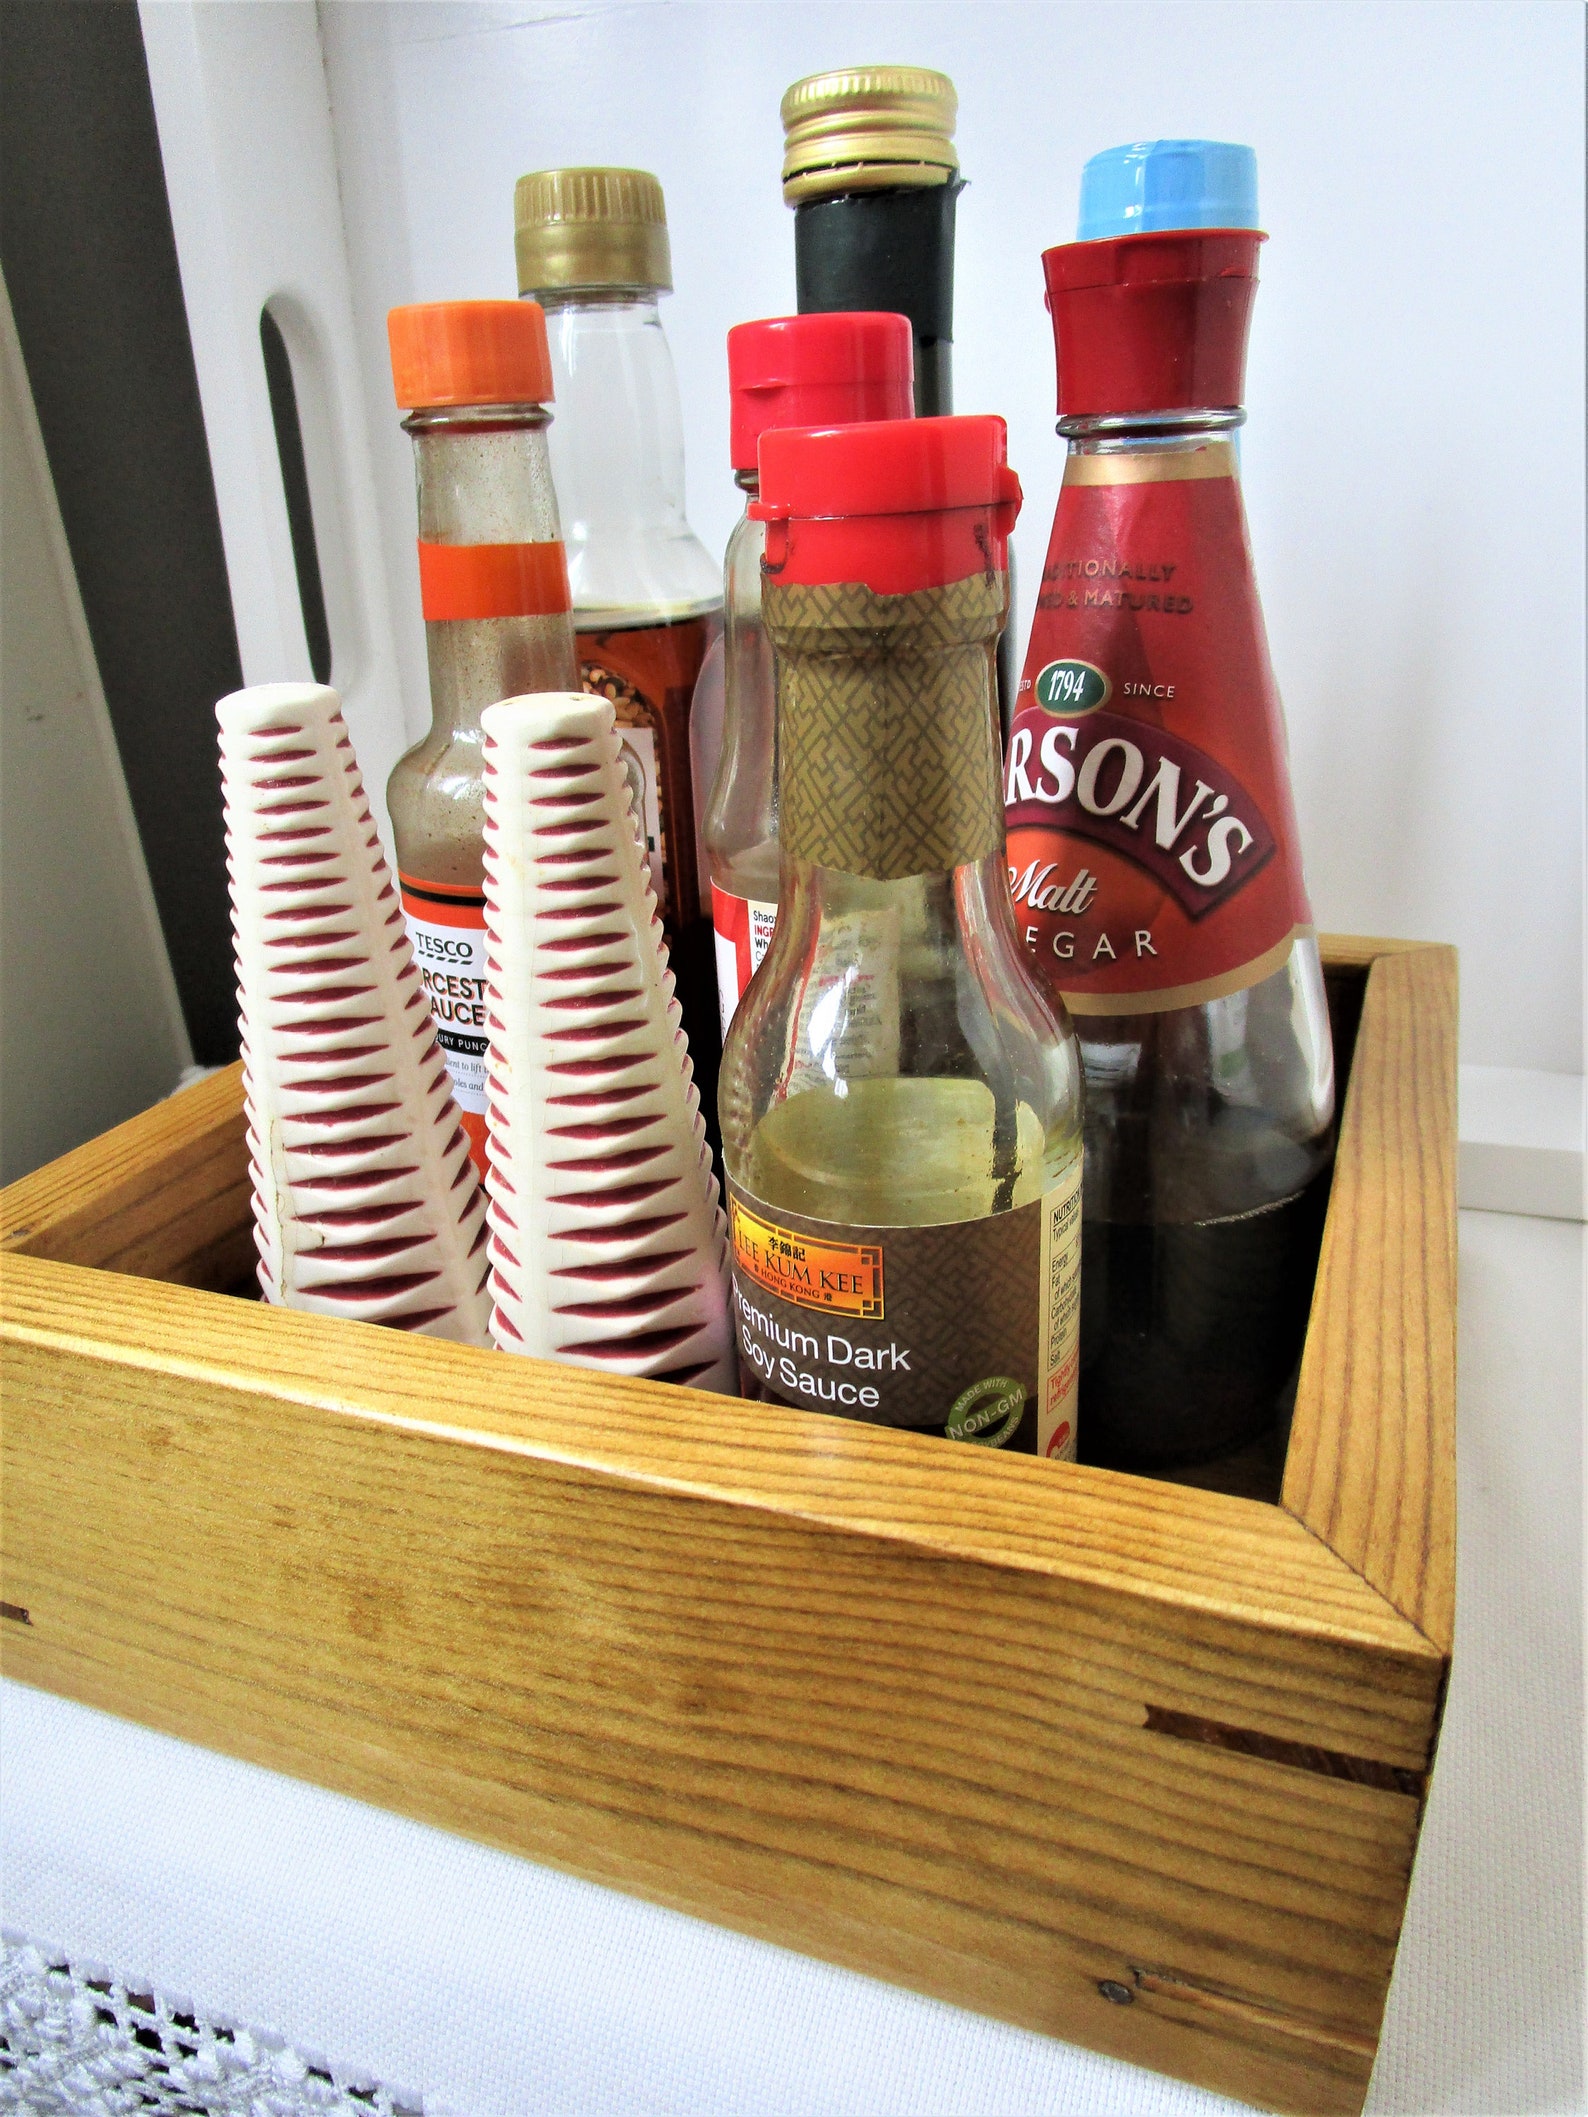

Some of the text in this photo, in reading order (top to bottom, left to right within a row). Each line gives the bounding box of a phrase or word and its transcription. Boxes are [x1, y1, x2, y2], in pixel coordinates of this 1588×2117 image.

[1048, 669, 1087, 702] 1794
[1123, 681, 1176, 699] SINCE
[1008, 859, 1098, 915] Malt
[415, 931, 473, 958] TESCO
[468, 1082, 484, 1092] and
[738, 1230, 864, 1295] LEE KUM KEE
[761, 1268, 787, 1288] HONG
[789, 1283, 820, 1299] KONG
[731, 1271, 912, 1371] Premium Dark
[742, 1324, 880, 1408] Soy Sauce
[955, 1378, 1009, 1412] MADE WITH
